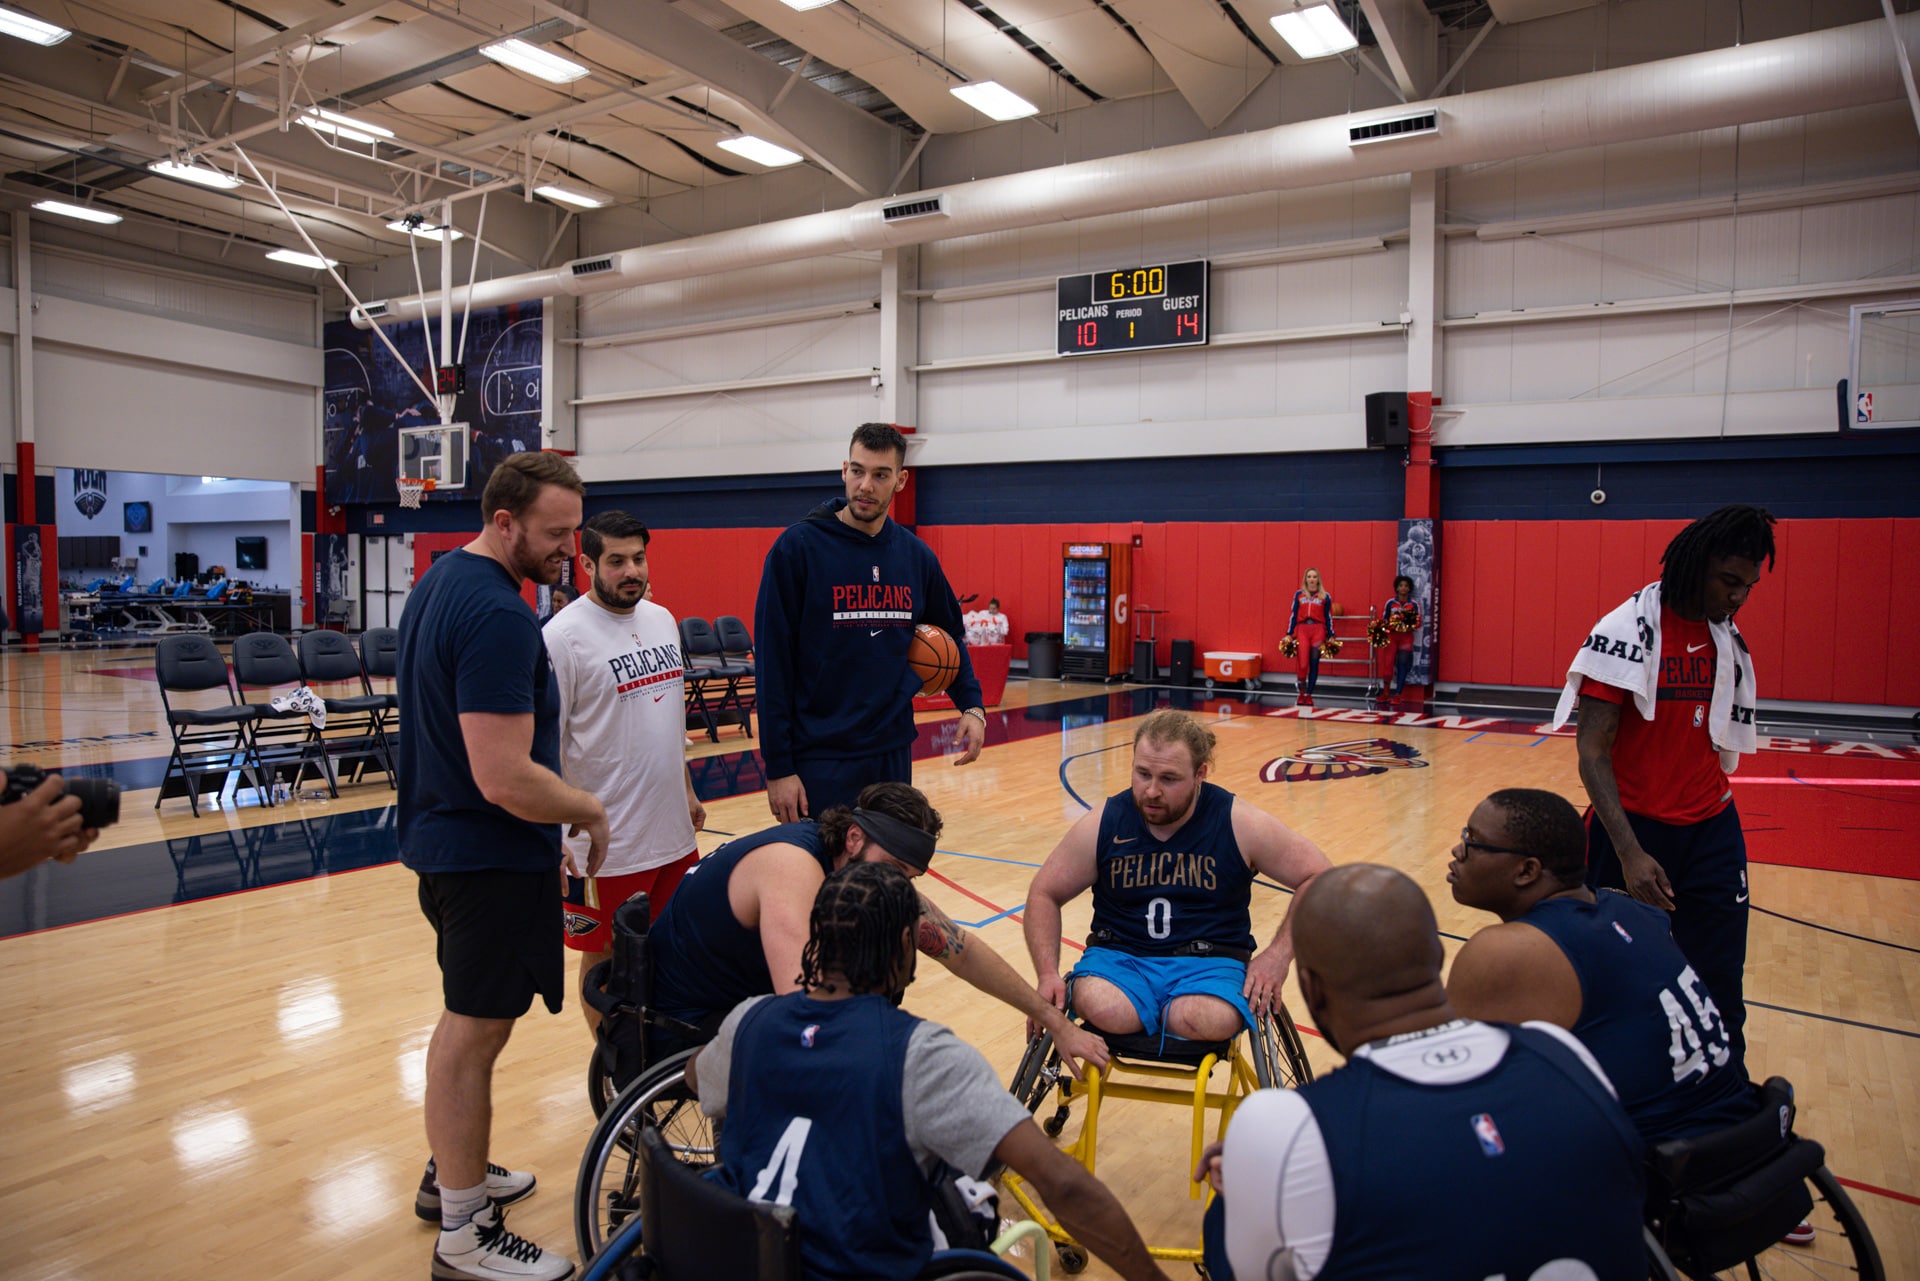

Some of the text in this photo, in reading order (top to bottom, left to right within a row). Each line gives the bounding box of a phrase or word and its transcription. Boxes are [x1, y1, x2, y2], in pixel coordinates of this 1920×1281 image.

[1111, 268, 1163, 298] 6:00
[1059, 305, 1109, 322] PELICANS
[1116, 308, 1143, 319] PERIOD
[1163, 295, 1199, 311] GUEST
[1077, 321, 1097, 347] 10
[1129, 321, 1135, 339] 1
[1176, 313, 1198, 337] 14
[437, 368, 456, 392] 24
[832, 584, 913, 610] PELICANS
[1114, 593, 1127, 625] G
[1432, 587, 1440, 643] GRAHAM
[608, 643, 682, 684] PELICANS
[1219, 660, 1232, 676] G
[1265, 705, 1505, 729] NEW
[1110, 852, 1217, 890] PELICANS
[1145, 897, 1173, 940] 0
[1659, 964, 1730, 1083] 45
[747, 1116, 812, 1207] 4
